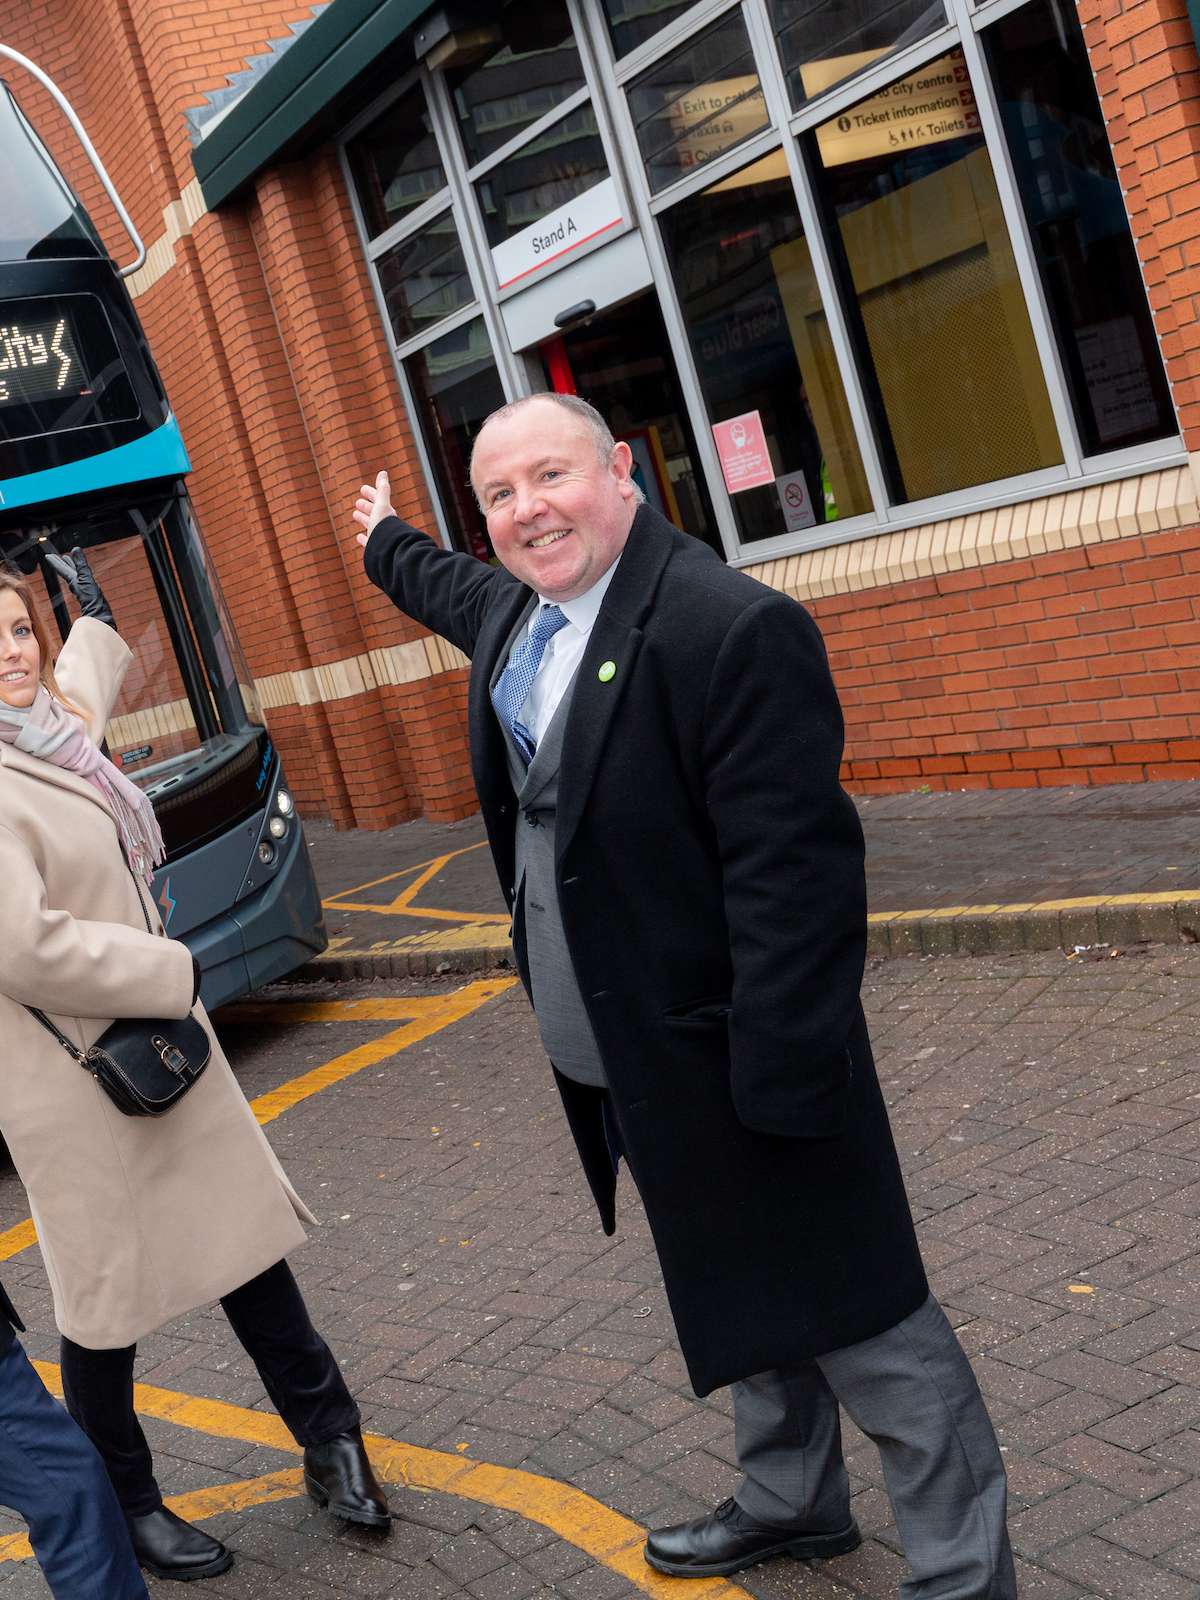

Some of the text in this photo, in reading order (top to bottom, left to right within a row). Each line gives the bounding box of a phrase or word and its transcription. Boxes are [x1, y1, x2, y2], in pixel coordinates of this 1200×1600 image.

[892, 82, 914, 95] city
[916, 73, 954, 90] centre
[683, 97, 707, 115] Exit
[709, 97, 722, 109] to
[853, 96, 959, 128] Ticket information
[927, 117, 965, 136] Toilets
[532, 217, 577, 254] Stand A
